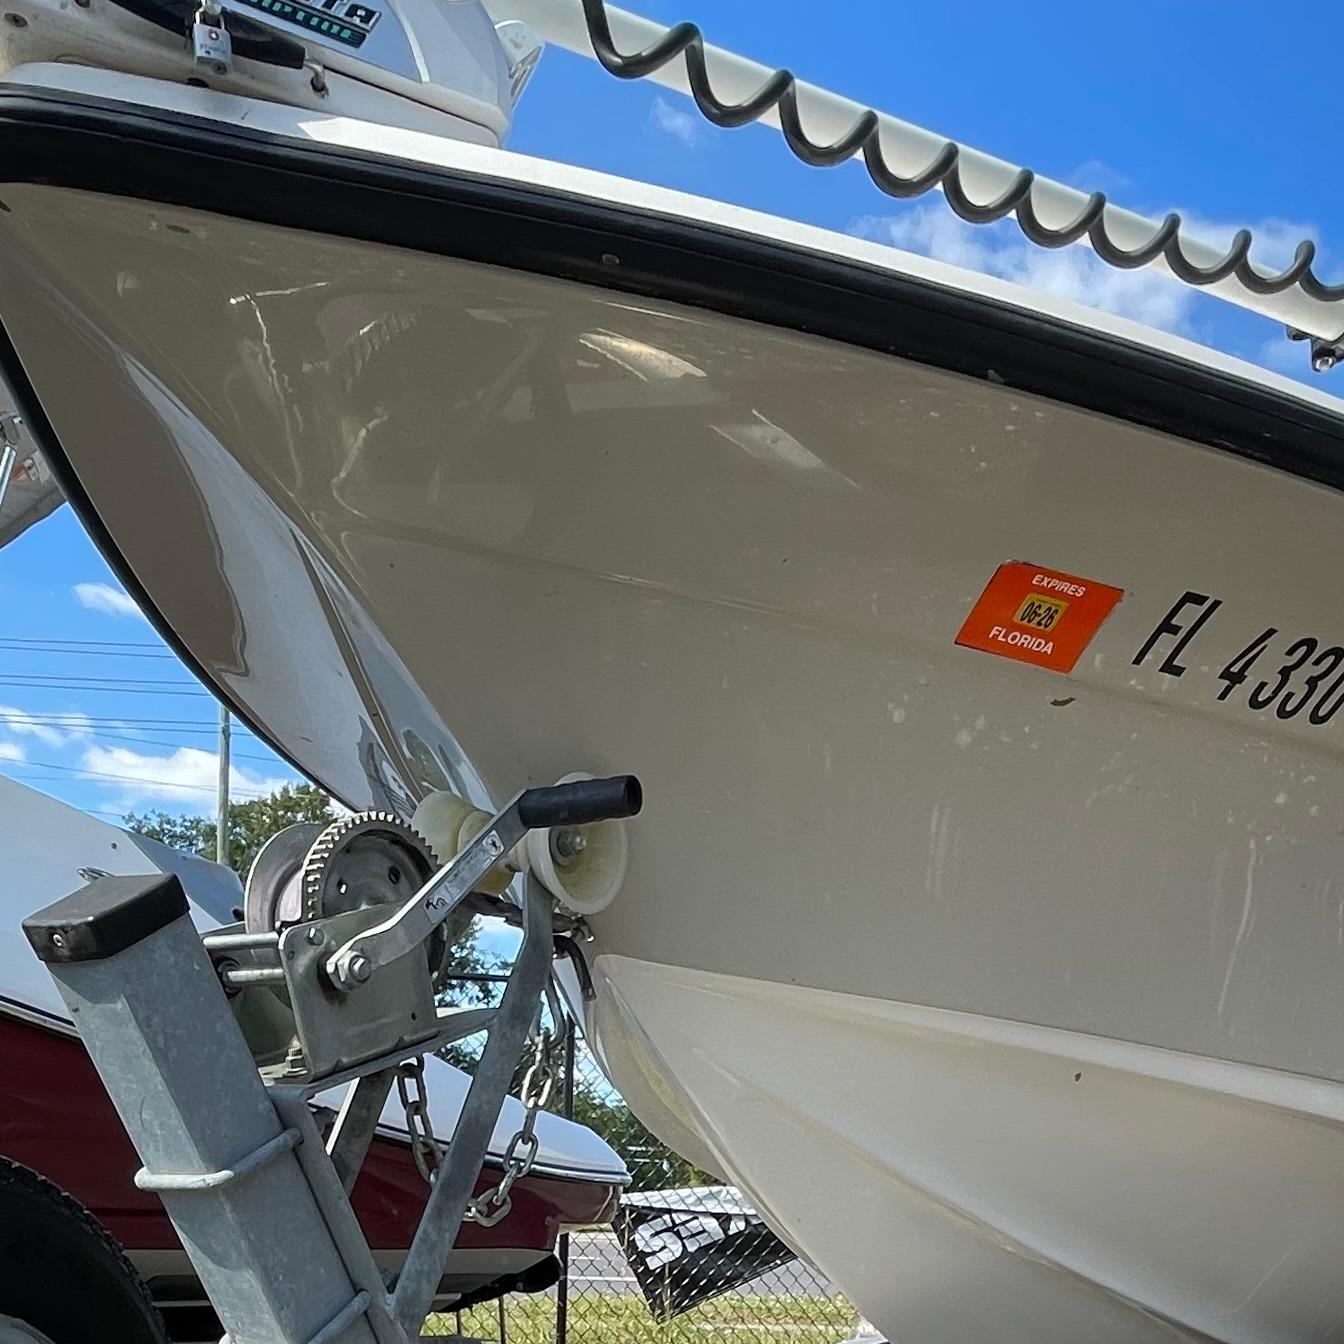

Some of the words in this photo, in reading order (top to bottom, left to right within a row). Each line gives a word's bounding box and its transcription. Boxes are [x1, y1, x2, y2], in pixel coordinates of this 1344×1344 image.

[1031, 574, 1087, 598] EXPIRES
[1019, 601, 1060, 629] 06-26
[988, 626, 1055, 656] FLORIDA
[1131, 590, 1223, 678] FL
